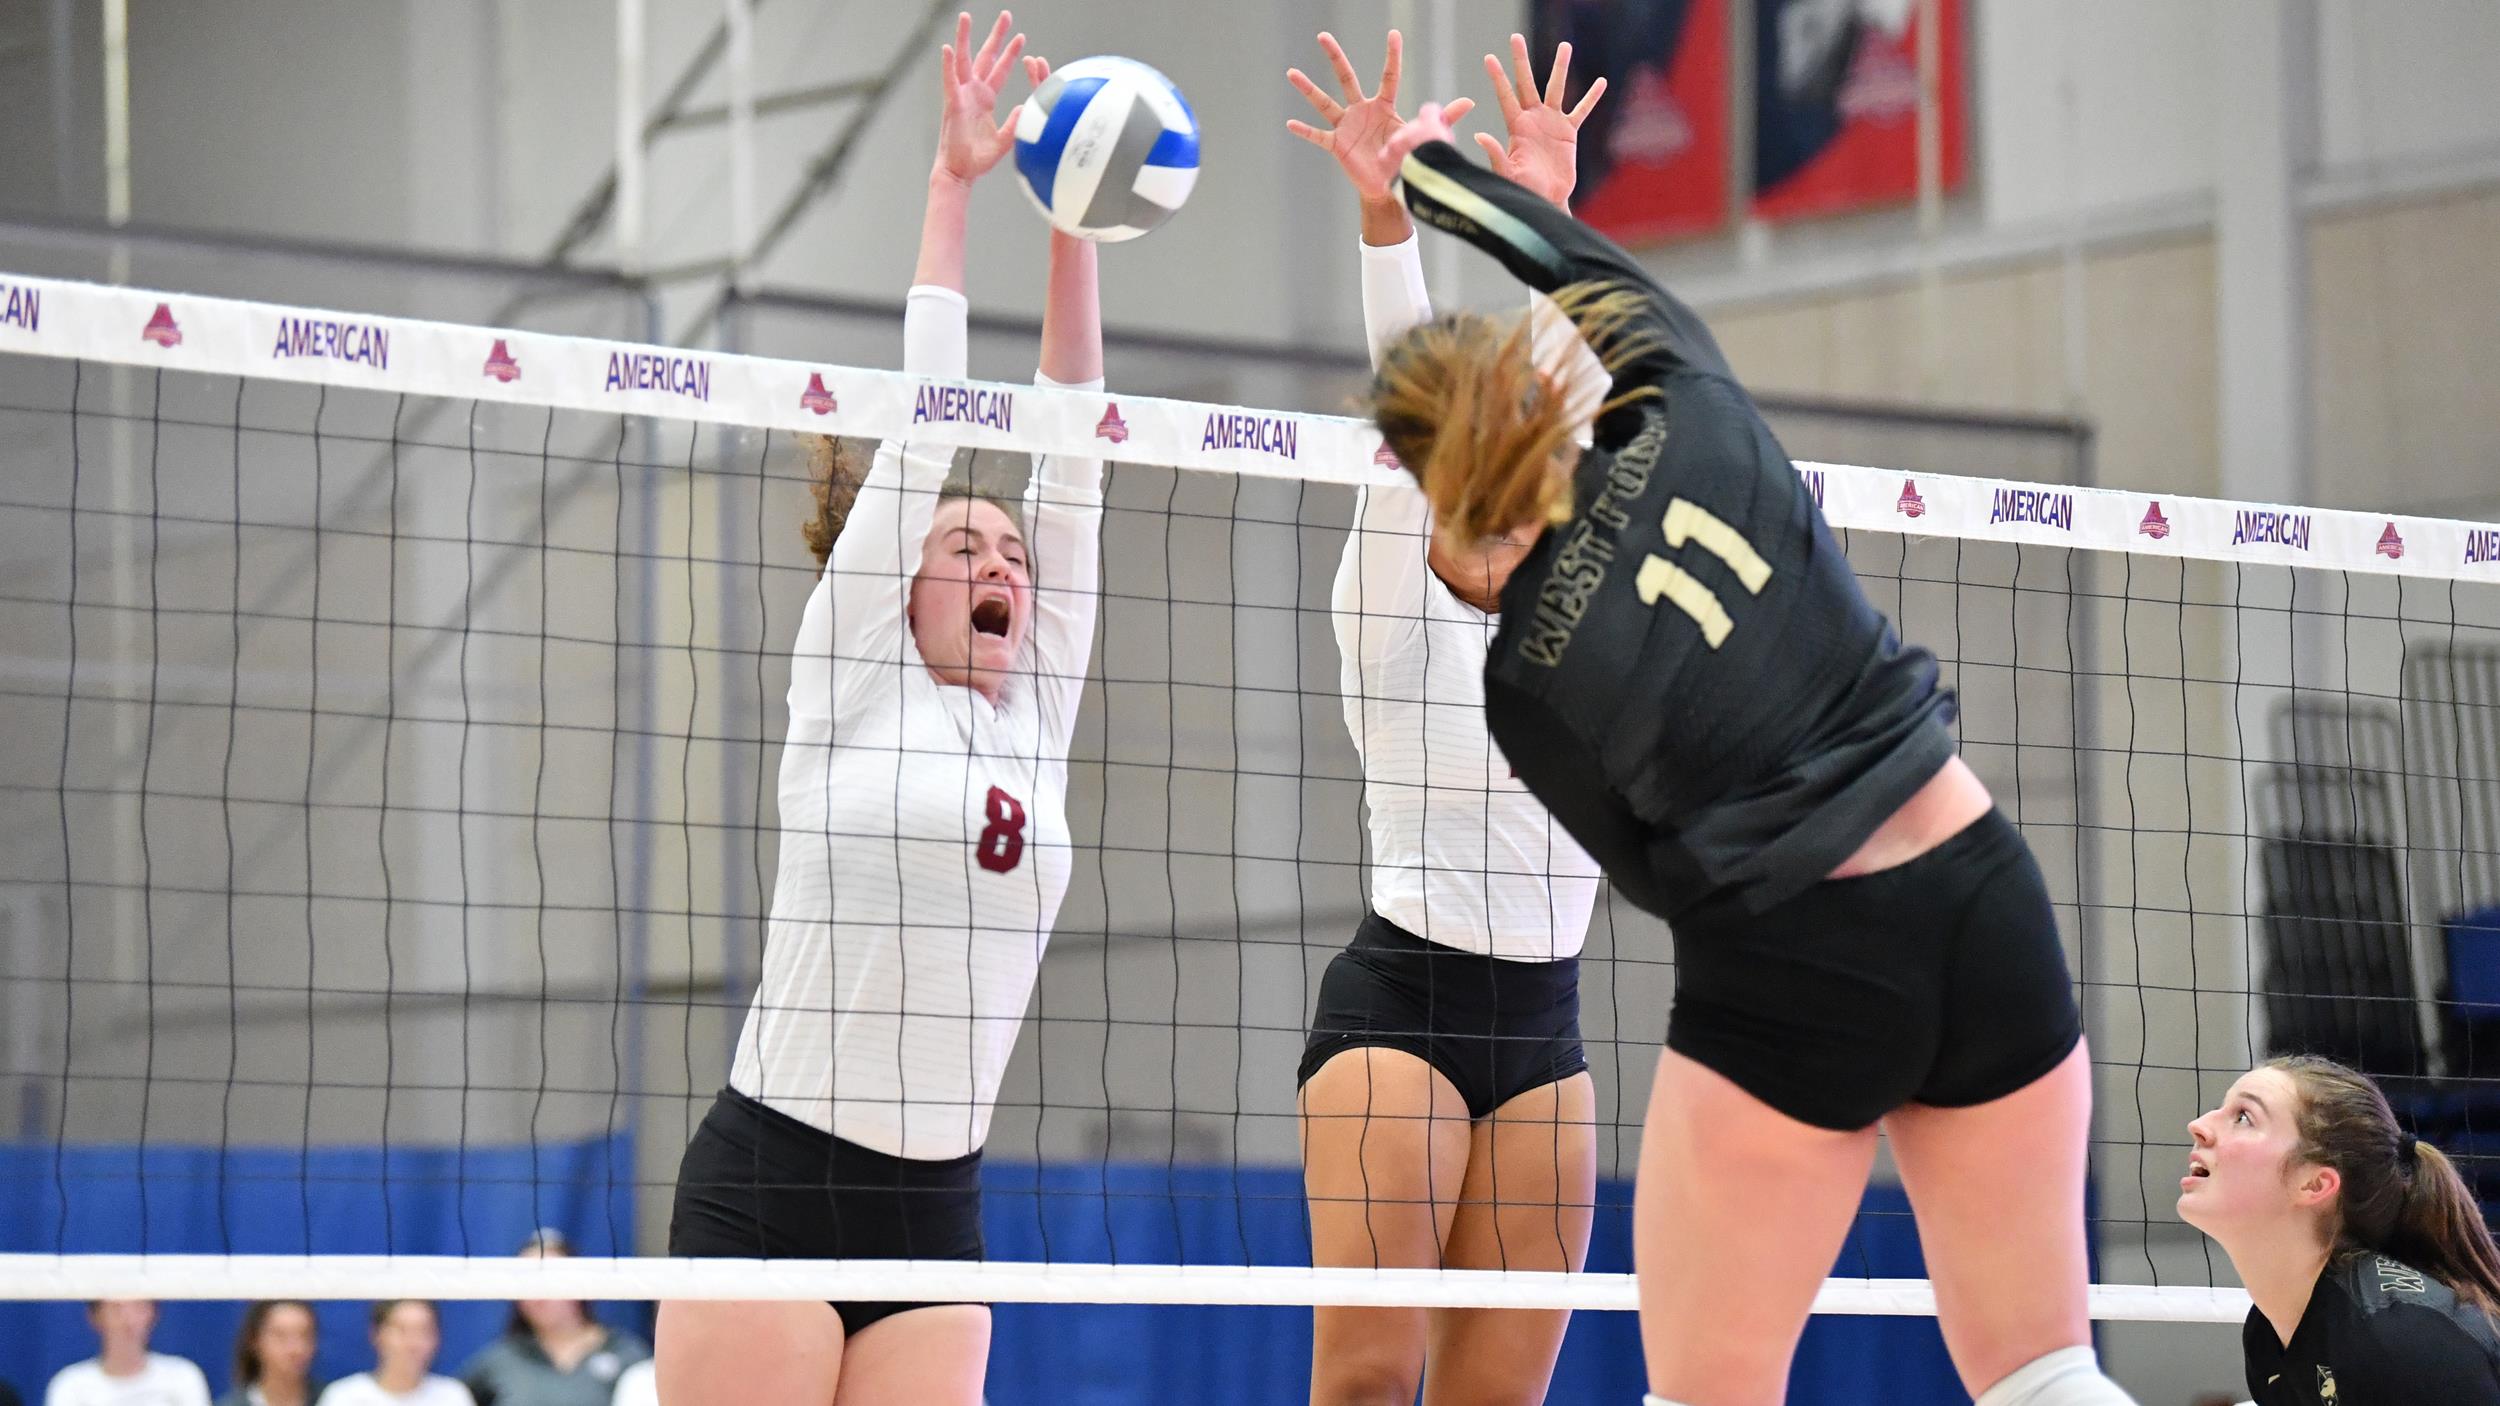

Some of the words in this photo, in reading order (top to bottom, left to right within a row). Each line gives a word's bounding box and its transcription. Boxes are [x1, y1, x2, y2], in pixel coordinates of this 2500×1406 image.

[273, 317, 389, 371] AMERICAN
[605, 351, 710, 402] AMERICAN
[912, 384, 1013, 433] AMERICAN
[1201, 413, 1297, 461] AMERICAN
[1989, 488, 2073, 532] AMERICAN
[2231, 509, 2311, 551] AMERICAN
[2464, 530, 2500, 564] AME
[1518, 518, 1615, 667] WEST
[1635, 497, 1774, 649] 11
[976, 784, 1026, 874] 8
